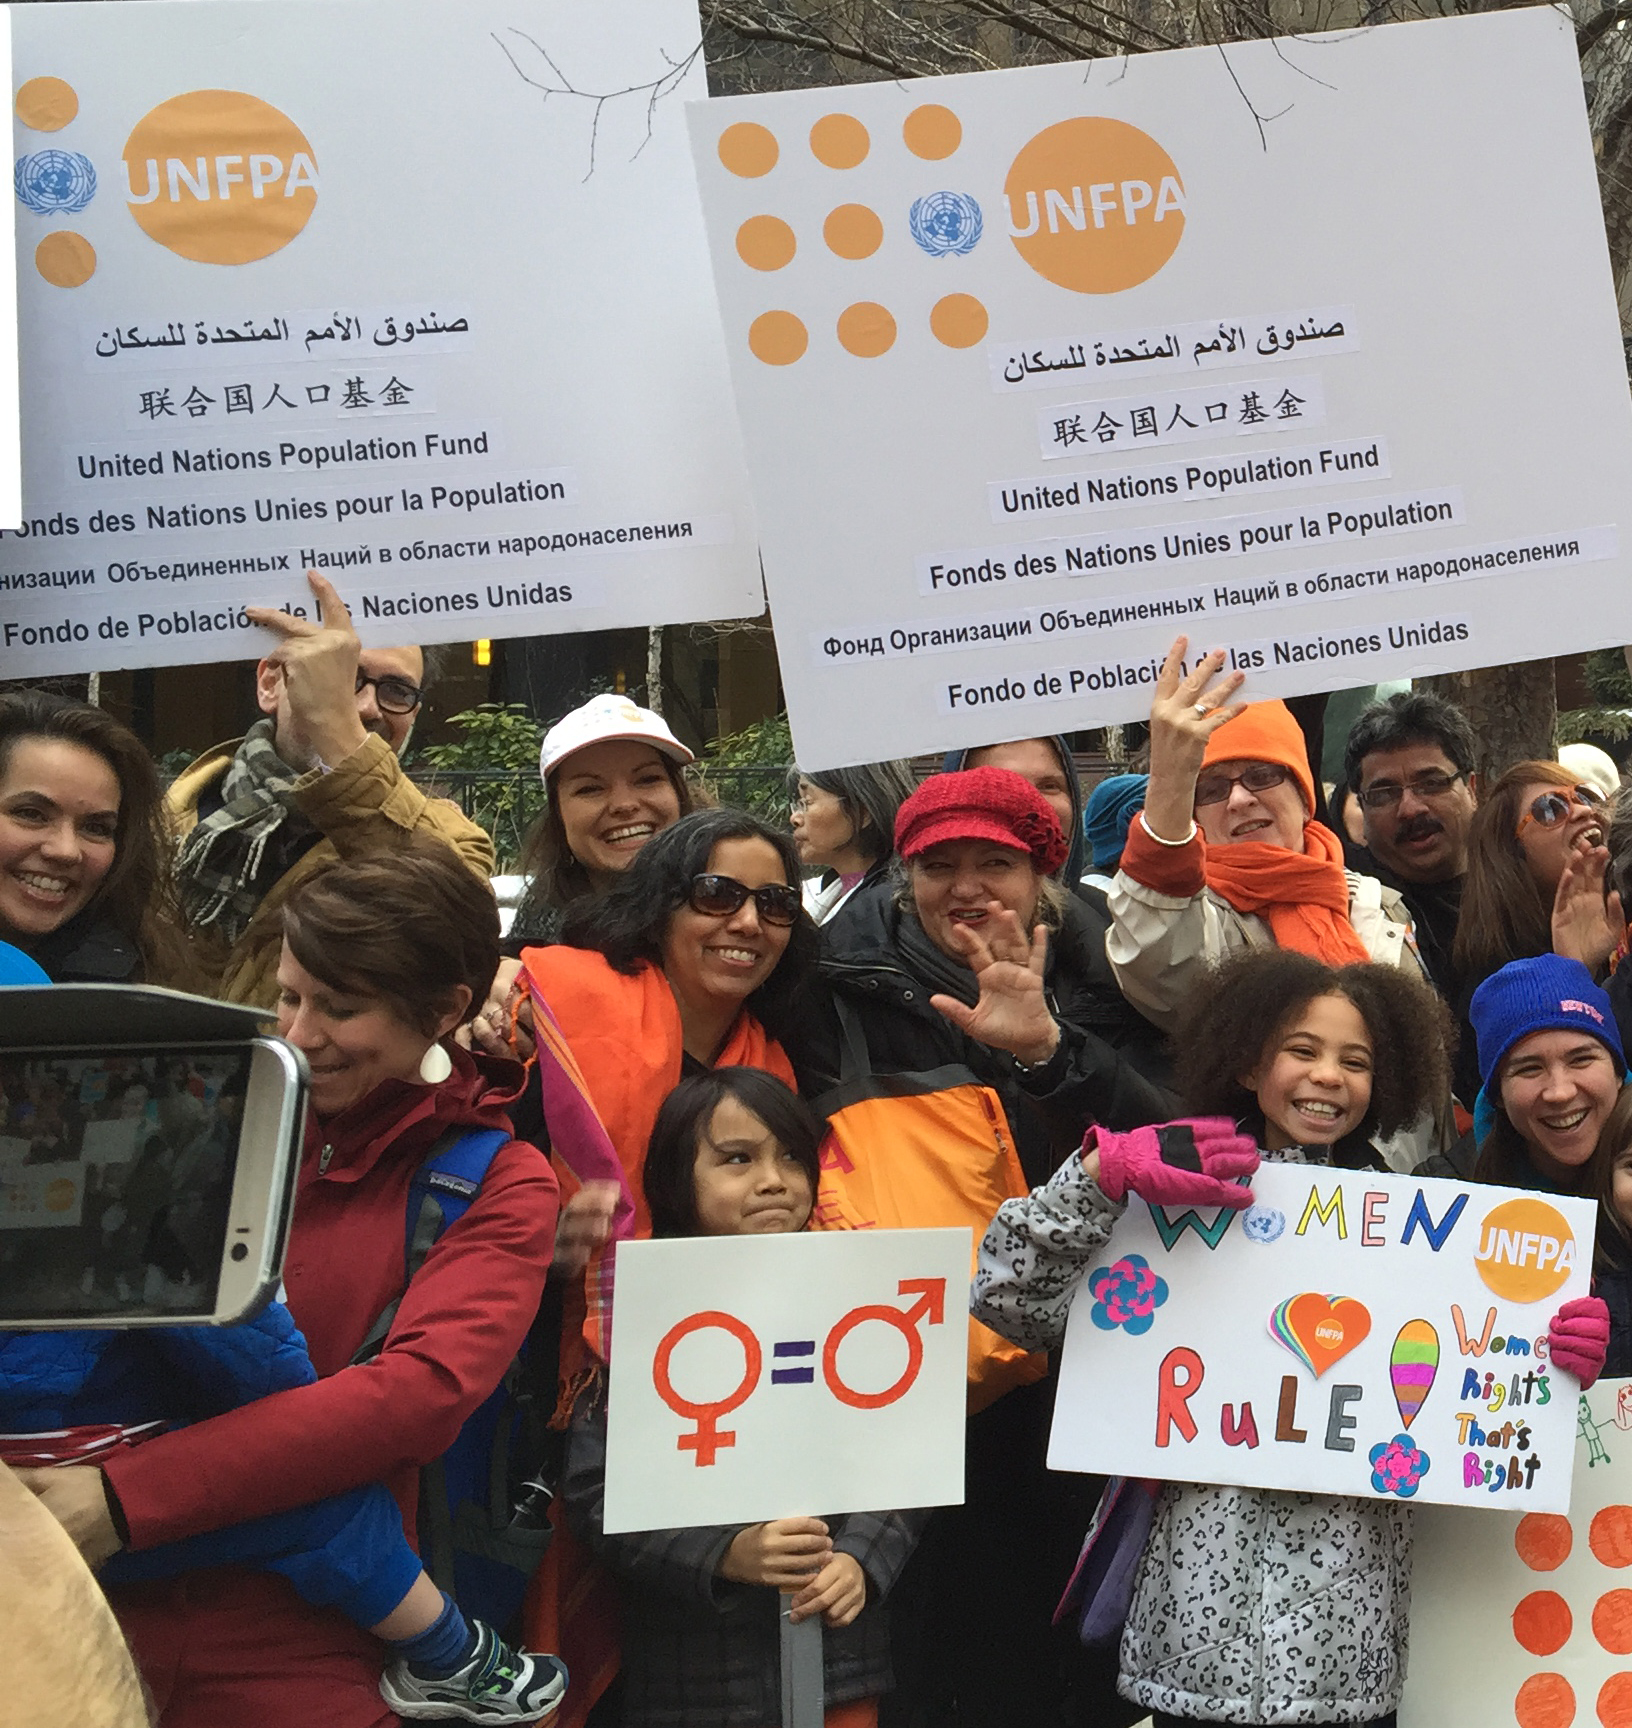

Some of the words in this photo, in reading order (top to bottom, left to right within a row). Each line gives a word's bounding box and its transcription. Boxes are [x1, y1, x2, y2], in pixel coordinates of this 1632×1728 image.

[119, 153, 320, 205] UNFPA
[1003, 176, 1187, 239] UNFPA
[95, 323, 185, 357] للسكان
[197, 317, 289, 345] المتحدة
[305, 312, 361, 352] الأمم
[373, 312, 469, 346] صندوق
[1095, 335, 1181, 366] المتحدة
[1194, 323, 1246, 366] الأمم
[1256, 317, 1345, 355] صندوق
[1003, 346, 1086, 383] للسكان
[139, 376, 415, 421] 联合国人口基金
[1053, 388, 1307, 448] 联合国人口基金
[77, 451, 164, 480] United
[173, 446, 271, 474] Nations
[279, 437, 417, 469] Population
[425, 431, 489, 458] Fund
[1001, 482, 1081, 514] United
[1087, 472, 1179, 503] Nations
[1186, 455, 1313, 492] Population
[1319, 444, 1380, 473] Fund
[0, 512, 80, 539] onds
[88, 510, 136, 534] des
[146, 503, 247, 530] Nations
[254, 497, 328, 523] Unies
[336, 491, 394, 522] pour
[401, 489, 424, 512] la
[430, 479, 566, 512] Population
[107, 553, 290, 585] Объединенных
[300, 545, 372, 571] Наций
[379, 549, 392, 563] в
[399, 540, 491, 563] области
[497, 521, 694, 556] народонаселения
[930, 558, 1007, 590] Fonds
[1014, 551, 1058, 578] des
[1065, 541, 1158, 572] Nations
[1163, 531, 1232, 560] Unies
[1240, 519, 1294, 553] pour
[1300, 516, 1322, 540] la
[1327, 498, 1454, 537] Population
[3, 618, 90, 648] Fondo
[97, 616, 130, 639] de
[137, 605, 268, 637] Població
[361, 590, 480, 619] Naciones
[487, 581, 573, 609] Unidas
[823, 634, 886, 658] Фонд
[890, 615, 1033, 654] Организации
[1039, 594, 1207, 634] Объединенных
[1214, 579, 1281, 609] Наций
[1286, 581, 1299, 598] в
[1304, 566, 1390, 597] области
[1396, 538, 1581, 583] народонаселения
[948, 678, 1026, 708] Fondo
[1033, 673, 1063, 698] de
[1230, 648, 1265, 671] las
[1273, 631, 1382, 666] Naciones
[1388, 618, 1469, 650] Unidas
[1476, 1222, 1578, 1274] UNFPA
[1450, 1303, 1549, 1360] Wome
[1463, 1451, 1541, 1493] Right
